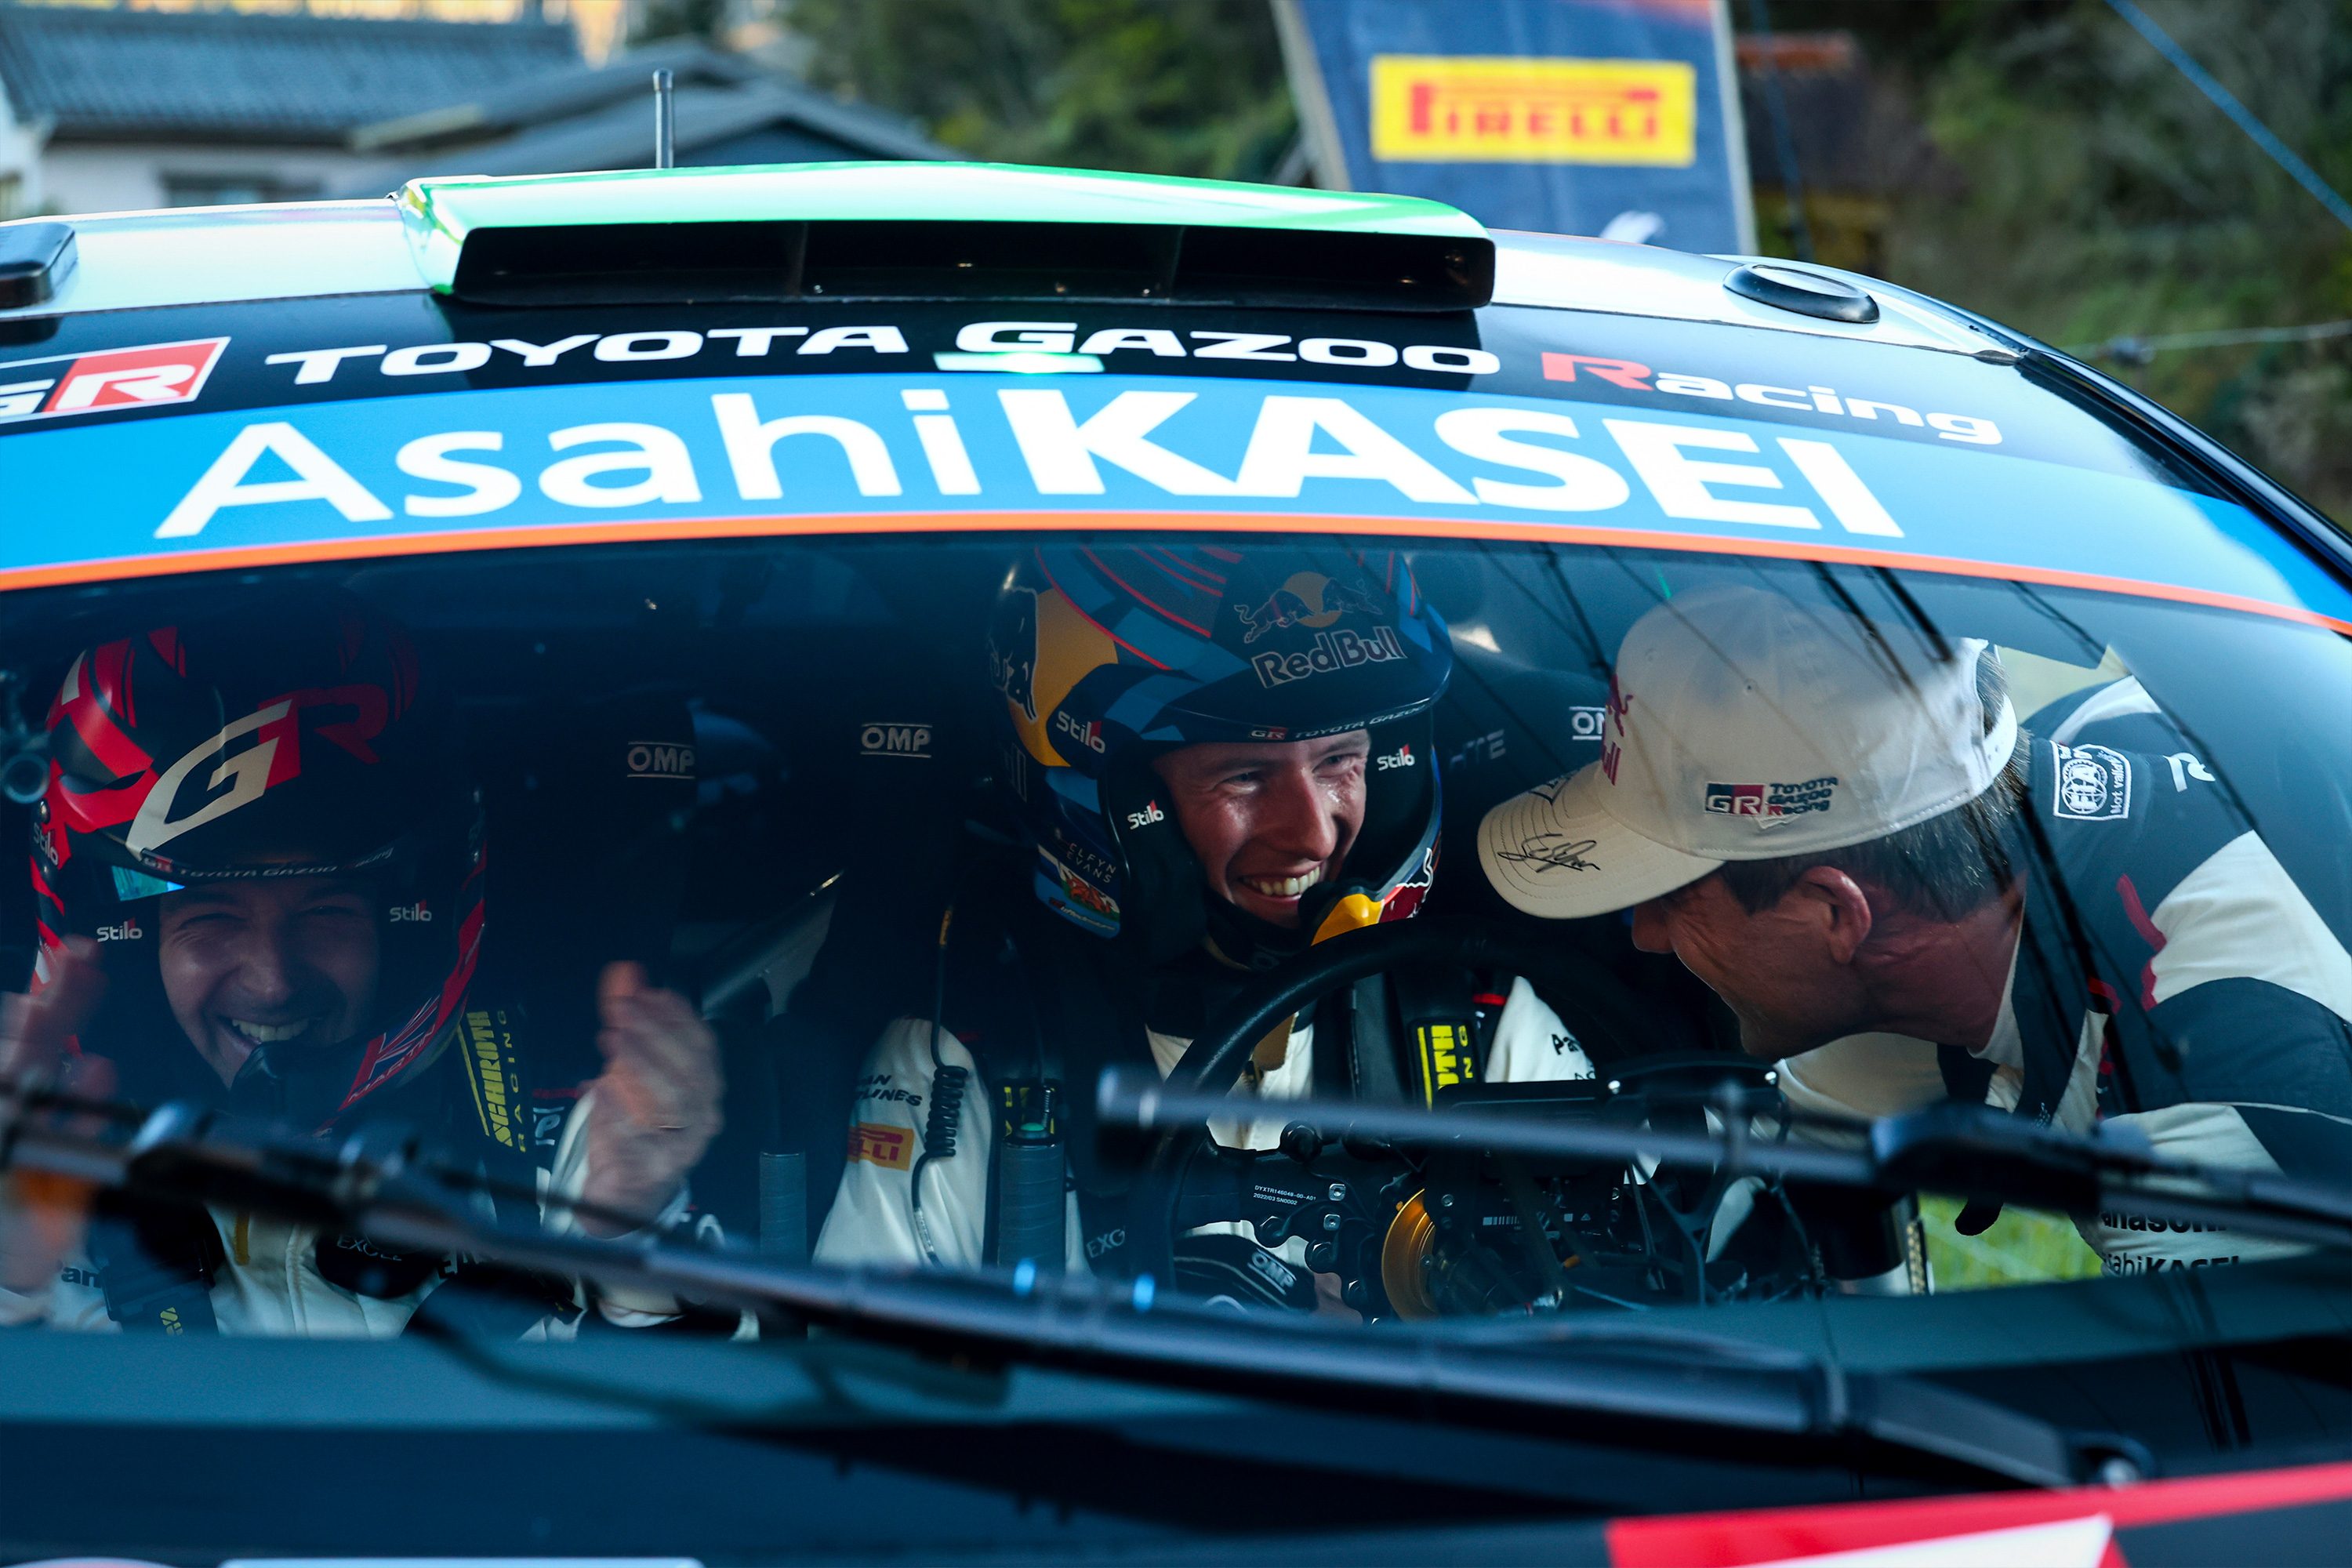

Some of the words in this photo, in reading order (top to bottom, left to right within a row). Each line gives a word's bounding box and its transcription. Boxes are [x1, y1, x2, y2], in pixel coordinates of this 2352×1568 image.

[1411, 83, 1659, 140] PIRELLI
[264, 325, 909, 385] TOYOTA
[955, 321, 1501, 375] GAZOO
[1542, 352, 2003, 445] Racing
[153, 388, 1905, 539] AsahiKASEI
[1251, 648, 1341, 690] Red
[1330, 626, 1408, 667] Bull
[862, 726, 931, 752] OMP
[1056, 710, 1106, 754] Stilo
[628, 746, 695, 773] OMP
[1377, 746, 1416, 771] Stilo
[1768, 788, 1832, 804] GAZOO
[1769, 777, 1838, 794] TOYOTA
[1127, 803, 1165, 830] Stilo
[1707, 795, 1761, 815] GR
[33, 822, 59, 866] Stilo
[1069, 842, 1116, 874] ELFYN
[1067, 851, 1112, 884] EVANS
[390, 902, 432, 923] Stilo
[96, 920, 143, 943] Stilo
[466, 1011, 514, 1148] SCHROTH
[1252, 1250, 1295, 1288] OMP
